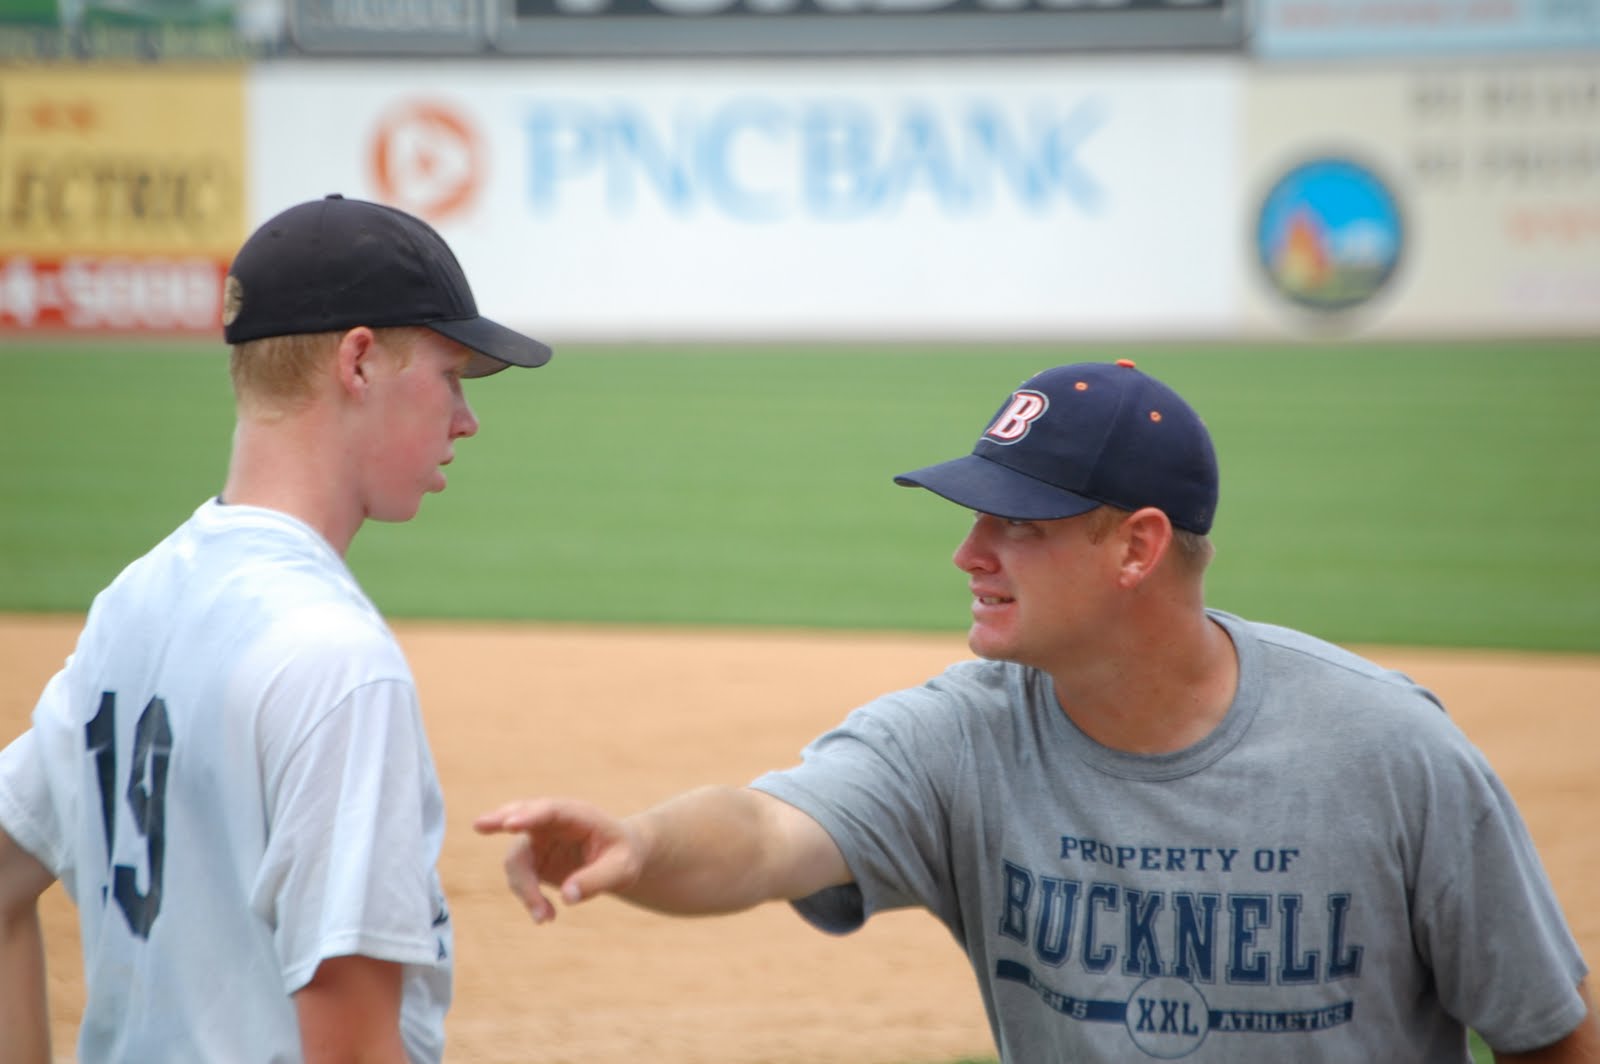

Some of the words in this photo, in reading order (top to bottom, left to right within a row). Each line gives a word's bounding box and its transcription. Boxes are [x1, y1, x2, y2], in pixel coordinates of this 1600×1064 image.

[980, 389, 1049, 446] B
[85, 690, 173, 942] 19
[1061, 836, 1238, 872] PROPERTY
[1254, 849, 1299, 873] OF
[999, 859, 1364, 987] BUCKNELL
[1136, 998, 1199, 1036] XXL
[1219, 1004, 1346, 1031] ATHLETICS
